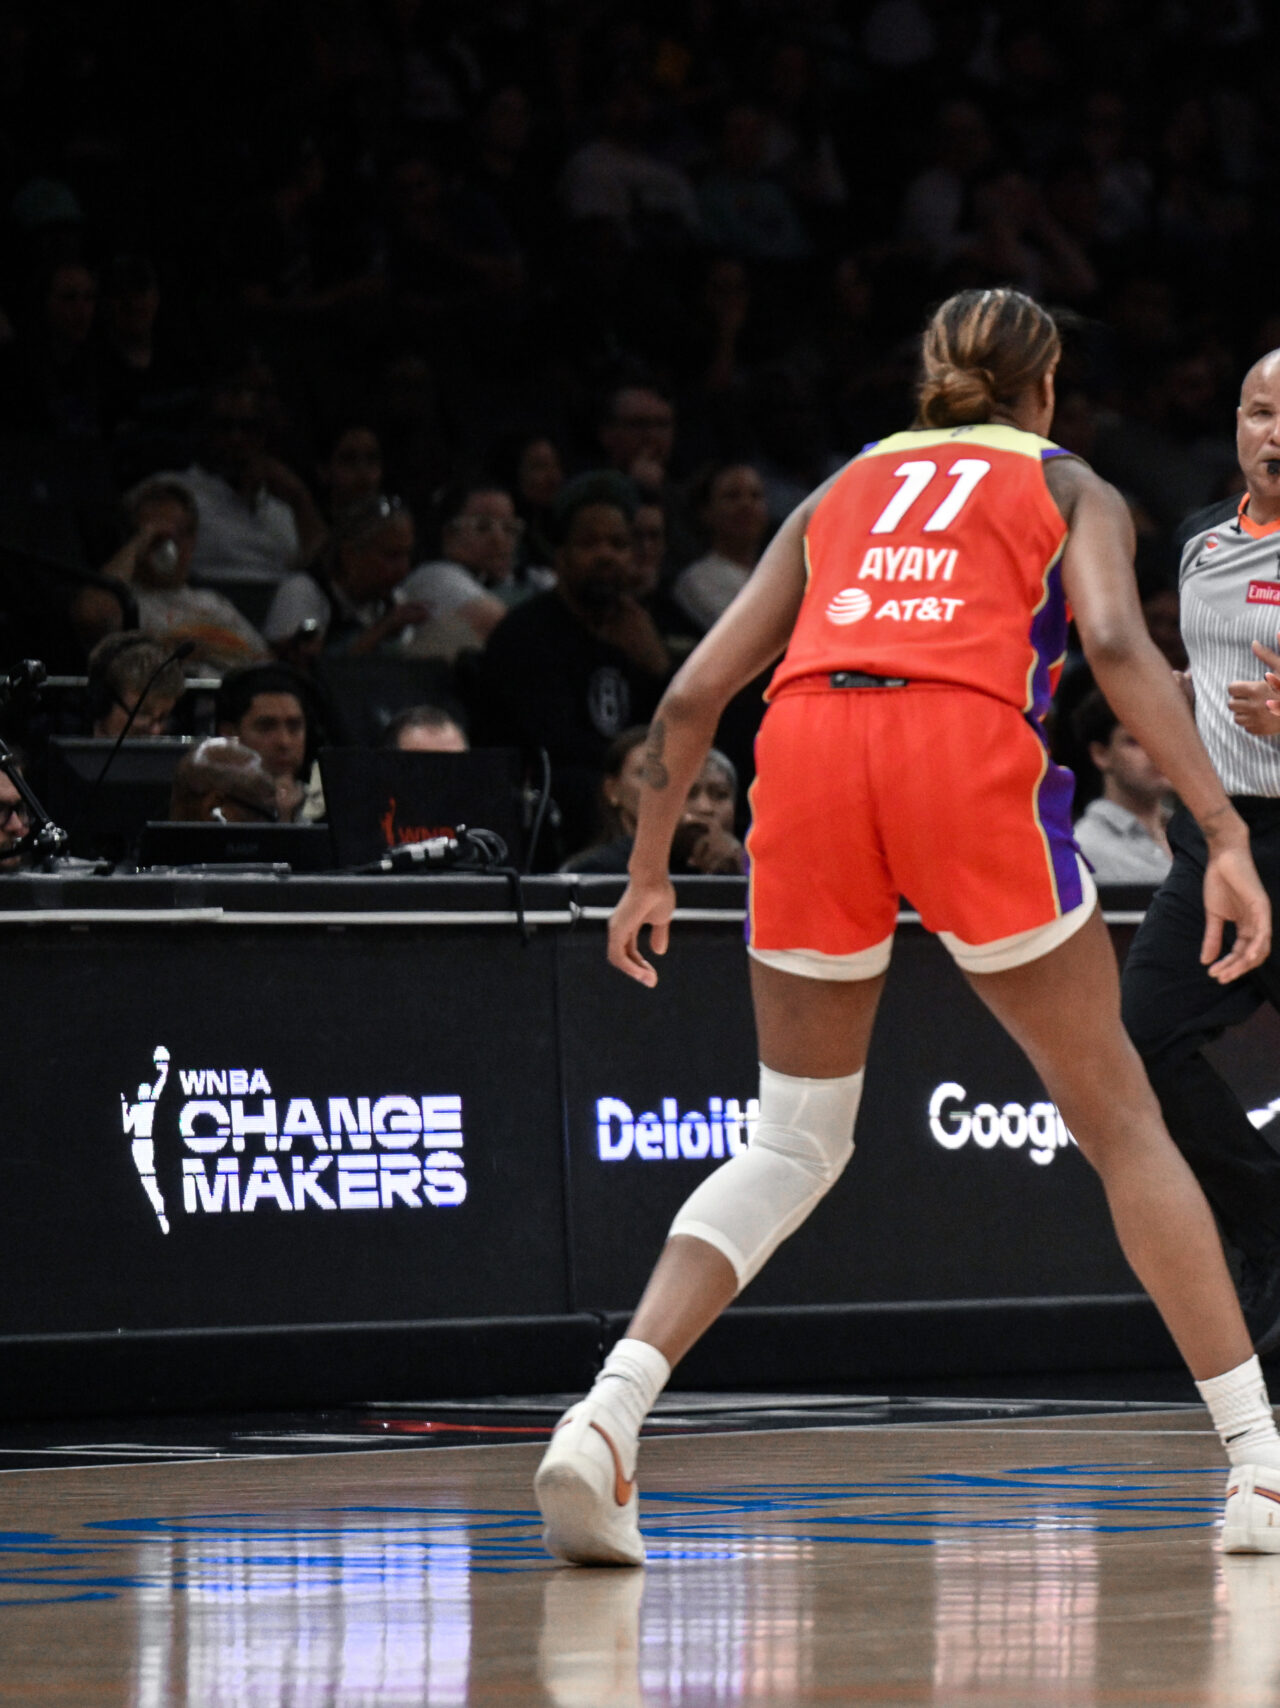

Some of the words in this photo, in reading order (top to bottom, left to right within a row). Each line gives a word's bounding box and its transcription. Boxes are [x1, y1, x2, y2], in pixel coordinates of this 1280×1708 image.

[870, 458, 991, 535] 11
[857, 546, 959, 582] AYAYI
[874, 596, 965, 623] AT&T
[179, 1068, 272, 1095] WNBA
[178, 1094, 464, 1154] CHANGE
[596, 1096, 760, 1161] Deloitt
[928, 1081, 1080, 1166] Googl
[181, 1150, 469, 1213] MAKERS
